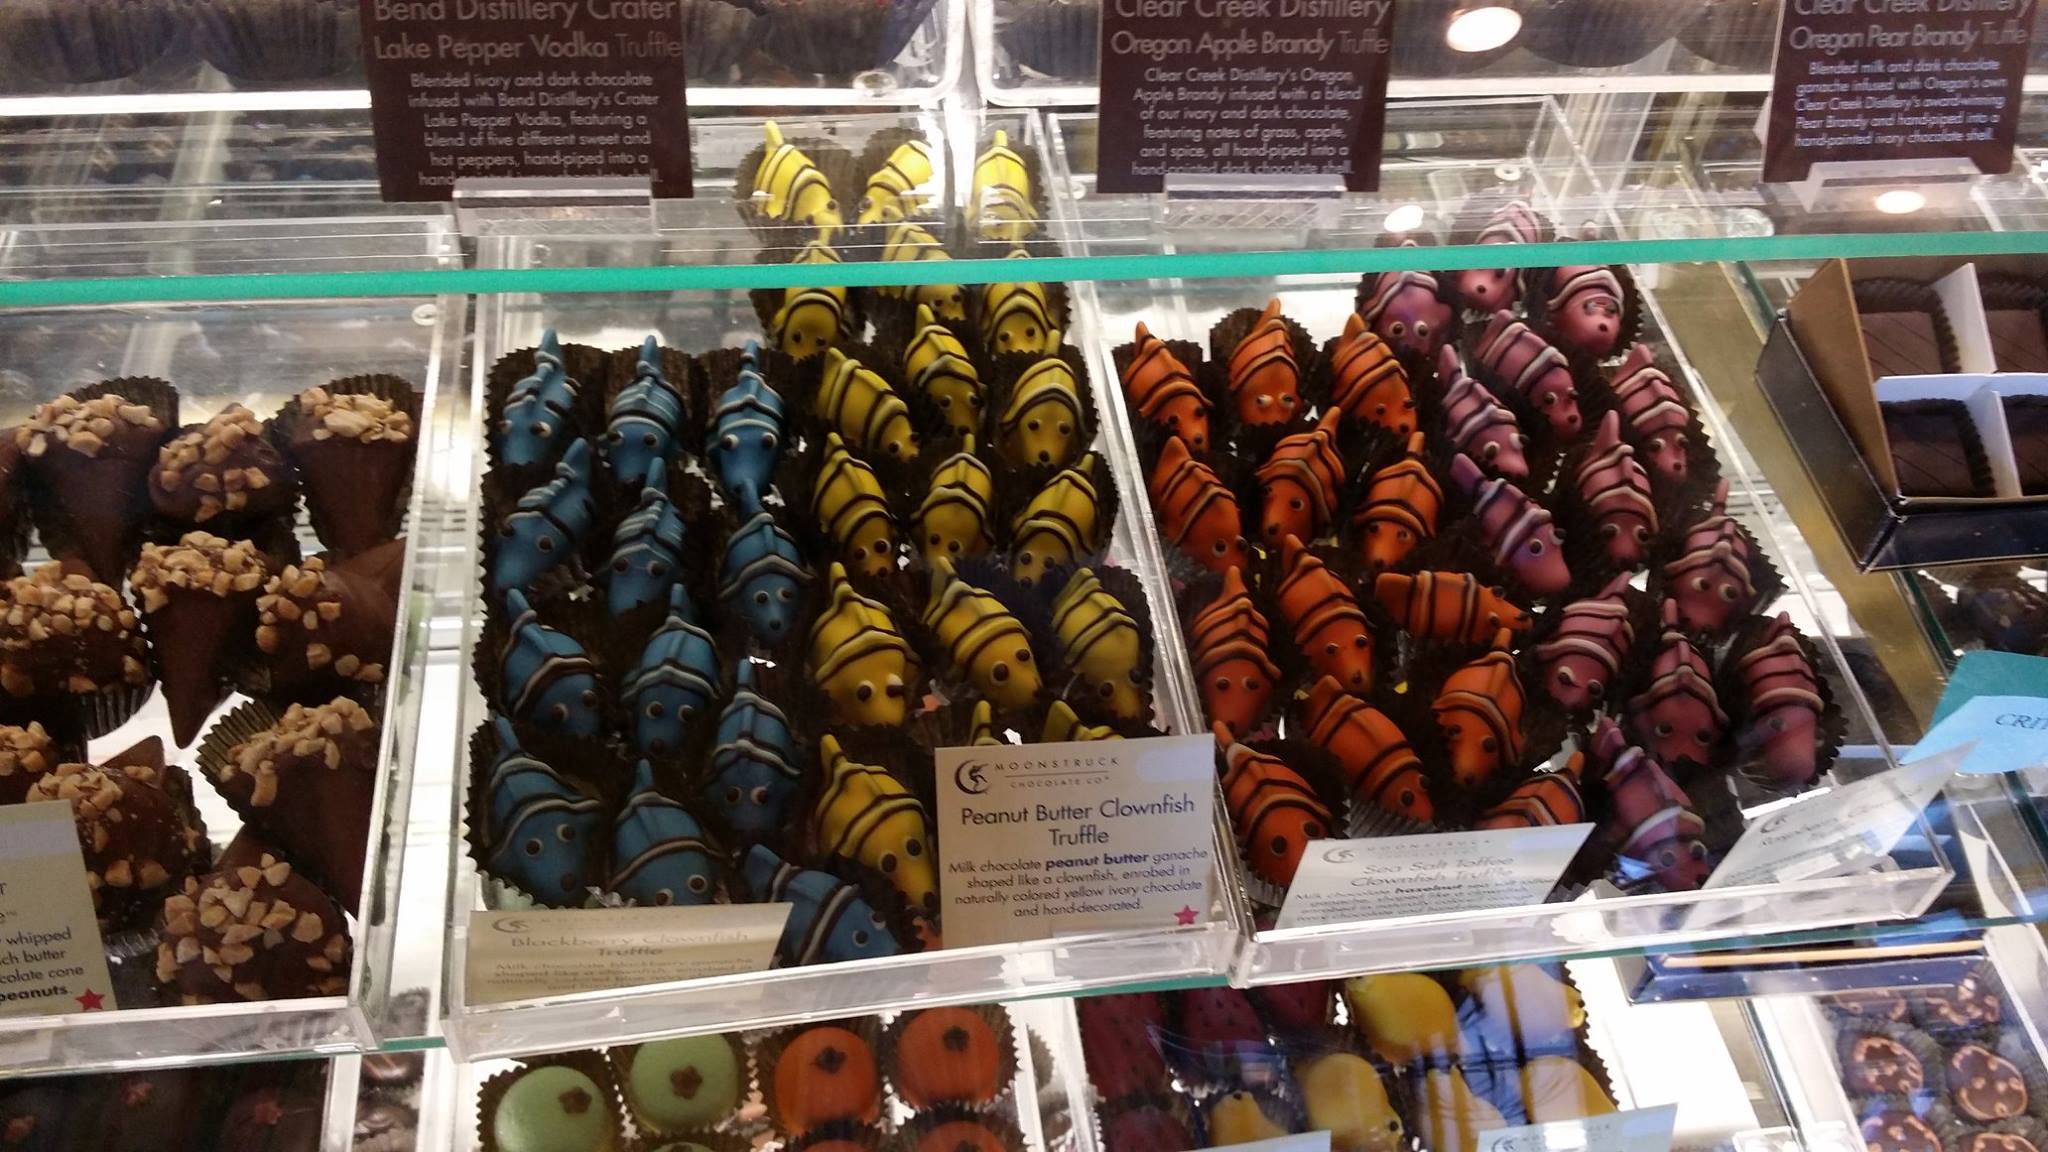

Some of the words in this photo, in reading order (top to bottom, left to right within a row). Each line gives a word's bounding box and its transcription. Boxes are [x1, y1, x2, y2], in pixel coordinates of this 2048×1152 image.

[375, 0, 446, 21] Bend
[456, 0, 578, 29] Distillery
[587, 0, 677, 20] Crater
[1115, 0, 1188, 17] Clear
[1195, 0, 1271, 17] Creek
[1280, 0, 1390, 26] Distillery
[1110, 30, 1191, 61] Oregon
[1196, 28, 1258, 61] Apple
[1262, 28, 1335, 61] Brandy
[1337, 28, 1389, 53] Truffle
[1789, 26, 1864, 56] Oregon
[1866, 24, 1911, 48] Pear
[1911, 20, 1979, 52] Brandy
[1981, 19, 2028, 45] Truffle
[374, 32, 431, 59] Lake
[438, 34, 525, 66] Pepper
[529, 31, 609, 58] Vodka
[615, 31, 683, 57] Truffle
[1143, 67, 1183, 81] Clear
[1185, 67, 1225, 81] Creek
[1230, 66, 1297, 85] Distillery's
[1301, 67, 1353, 85] Oregon
[1808, 60, 1859, 75] Blended
[1860, 60, 1885, 73] milk
[1887, 59, 1914, 73] and
[1914, 58, 1942, 72] dark
[1944, 58, 2000, 71] chocolate
[410, 72, 471, 87] Blended
[473, 74, 511, 91] ivory
[514, 71, 544, 86] and
[547, 71, 581, 86] dark
[584, 70, 653, 86] chocolate
[1796, 79, 1850, 97] ganache
[1851, 77, 1895, 91] infused
[1896, 76, 1922, 90] with
[1924, 75, 1980, 93] Oregon's
[1981, 78, 2008, 89] own
[408, 92, 460, 107] infused
[463, 92, 495, 106] with
[498, 91, 536, 106] Bend
[539, 90, 612, 109] Distillery's
[614, 91, 660, 105] Crater
[1133, 86, 1174, 105] Apple
[1177, 86, 1226, 104] Brandy
[1228, 85, 1277, 100] infused
[1280, 86, 1308, 100] with
[1311, 90, 1322, 100] a
[1324, 86, 1363, 100] blend
[1795, 98, 1827, 111] Clear
[1828, 96, 1863, 110] Creek
[1864, 95, 1921, 112] Distillery's
[1923, 93, 2006, 109] award-winning
[424, 112, 458, 127] Lake
[461, 113, 512, 130] Pepper
[515, 111, 567, 128] Vodka,
[570, 110, 634, 129] featuring
[636, 115, 649, 126] a
[1140, 105, 1155, 119] of
[1157, 110, 1180, 119] our
[1183, 107, 1218, 123] ivory
[1220, 105, 1248, 119] and
[1250, 105, 1282, 119] dark
[1285, 104, 1351, 120] chocolate,
[1796, 116, 1823, 129] Pear
[1826, 114, 1869, 131] Brandy
[1870, 113, 1896, 127] and
[1897, 111, 1965, 129] hand-piped
[1966, 111, 1988, 123] into
[1990, 114, 2000, 123] a
[424, 132, 465, 147] blend
[468, 131, 484, 146] of
[487, 131, 513, 146] five
[516, 130, 576, 145] different
[579, 133, 619, 145] sweet
[622, 130, 652, 144] and
[1143, 124, 1203, 142] featuring
[1205, 128, 1241, 138] notes
[1243, 124, 1259, 138] of
[1261, 128, 1300, 142] grass,
[1305, 124, 1346, 141] apple,
[1795, 131, 1873, 149] hand-painted
[1874, 132, 1905, 147] ivory
[1907, 128, 1964, 143] chocolate
[430, 152, 454, 166] hot
[457, 156, 520, 170] peppers,
[523, 150, 604, 168] hand-piped
[608, 151, 635, 164] into
[638, 154, 649, 164] a
[1140, 143, 1167, 157] and
[1170, 144, 1208, 160] spice,
[1212, 142, 1230, 156] all
[1232, 142, 1308, 160] hand-piped
[1311, 143, 1336, 156] into
[1338, 147, 1349, 156] a
[1220, 161, 1251, 174] dark
[1255, 161, 1318, 174] chocolate
[994, 757, 1120, 771] MOONSTRUCK
[1010, 777, 1080, 789] CHOCOLATE
[961, 806, 1029, 825] Peanut
[1036, 804, 1093, 822] Butter
[1099, 792, 1194, 819] Clownfish
[1048, 824, 1109, 846] Truffle
[948, 860, 977, 873] Milk
[980, 858, 1041, 873] chocolate
[1045, 855, 1099, 872] peanut
[1103, 853, 1150, 865] butter
[1152, 847, 1208, 864] ganache
[1363, 864, 1401, 875] Sea
[1409, 859, 1448, 872] Salt
[1457, 855, 1514, 868] Toffee
[967, 875, 1014, 890] shaped
[1018, 873, 1040, 886] like
[1043, 875, 1053, 885] a
[1056, 869, 1118, 883] clownfish,
[1122, 864, 1175, 880] enrobed
[1179, 865, 1190, 876] in
[1351, 871, 1446, 887] Clownfish
[1456, 866, 1513, 880] Truffle
[1012, 888, 1060, 902] colored
[1063, 885, 1104, 901] yellow
[1108, 884, 1138, 897] ivory
[1143, 880, 1202, 894] chocolate
[1014, 904, 1039, 918] and
[1043, 898, 1143, 915] hand-decorated.
[6, 925, 72, 946] whipped
[511, 935, 633, 948] Blackberry
[642, 929, 750, 945] Clownfish
[22, 949, 66, 964] butter
[598, 945, 664, 957] Truffle
[48, 965, 84, 980] cone
